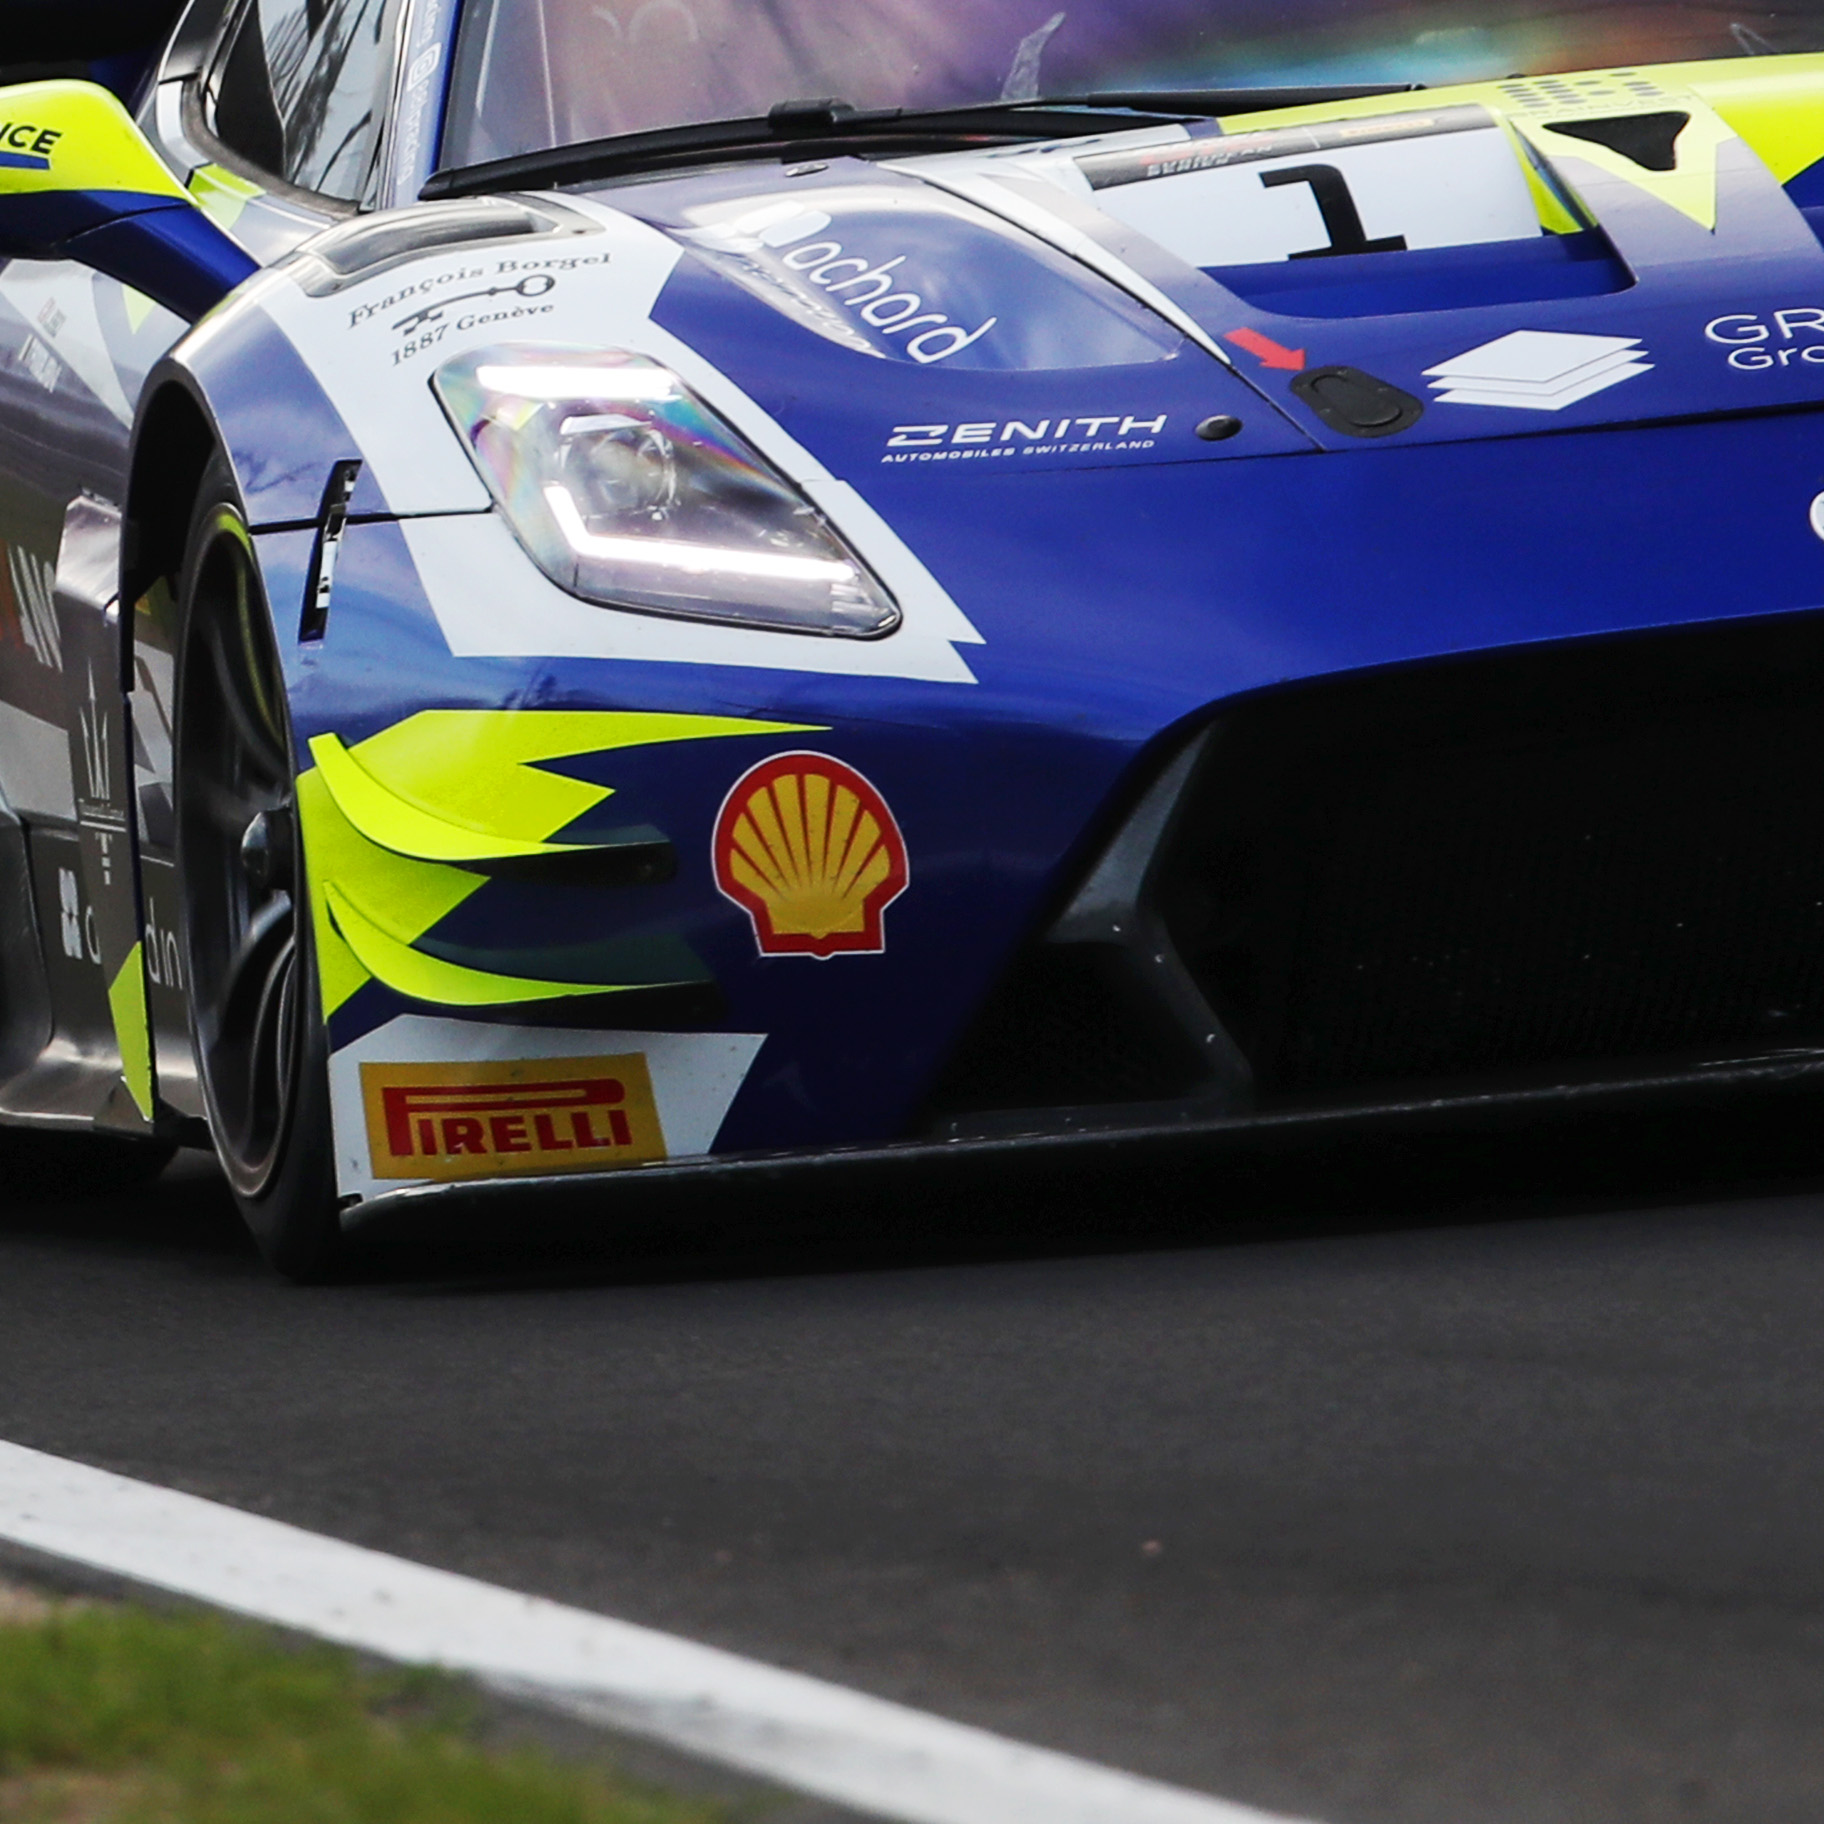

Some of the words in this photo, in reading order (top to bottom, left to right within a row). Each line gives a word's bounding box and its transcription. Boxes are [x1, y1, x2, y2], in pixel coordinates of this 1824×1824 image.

[1258, 164, 1407, 261] 1
[347, 267, 483, 329] François
[495, 253, 612, 274] Borgel
[392, 323, 449, 367] 1887
[456, 303, 555, 330] Genève
[880, 447, 1016, 463] AUTOMOBILES
[1022, 439, 1155, 456] SWITZERLAND
[886, 414, 1168, 447] ZENITH
[381, 1078, 633, 1158] PIRELLI
